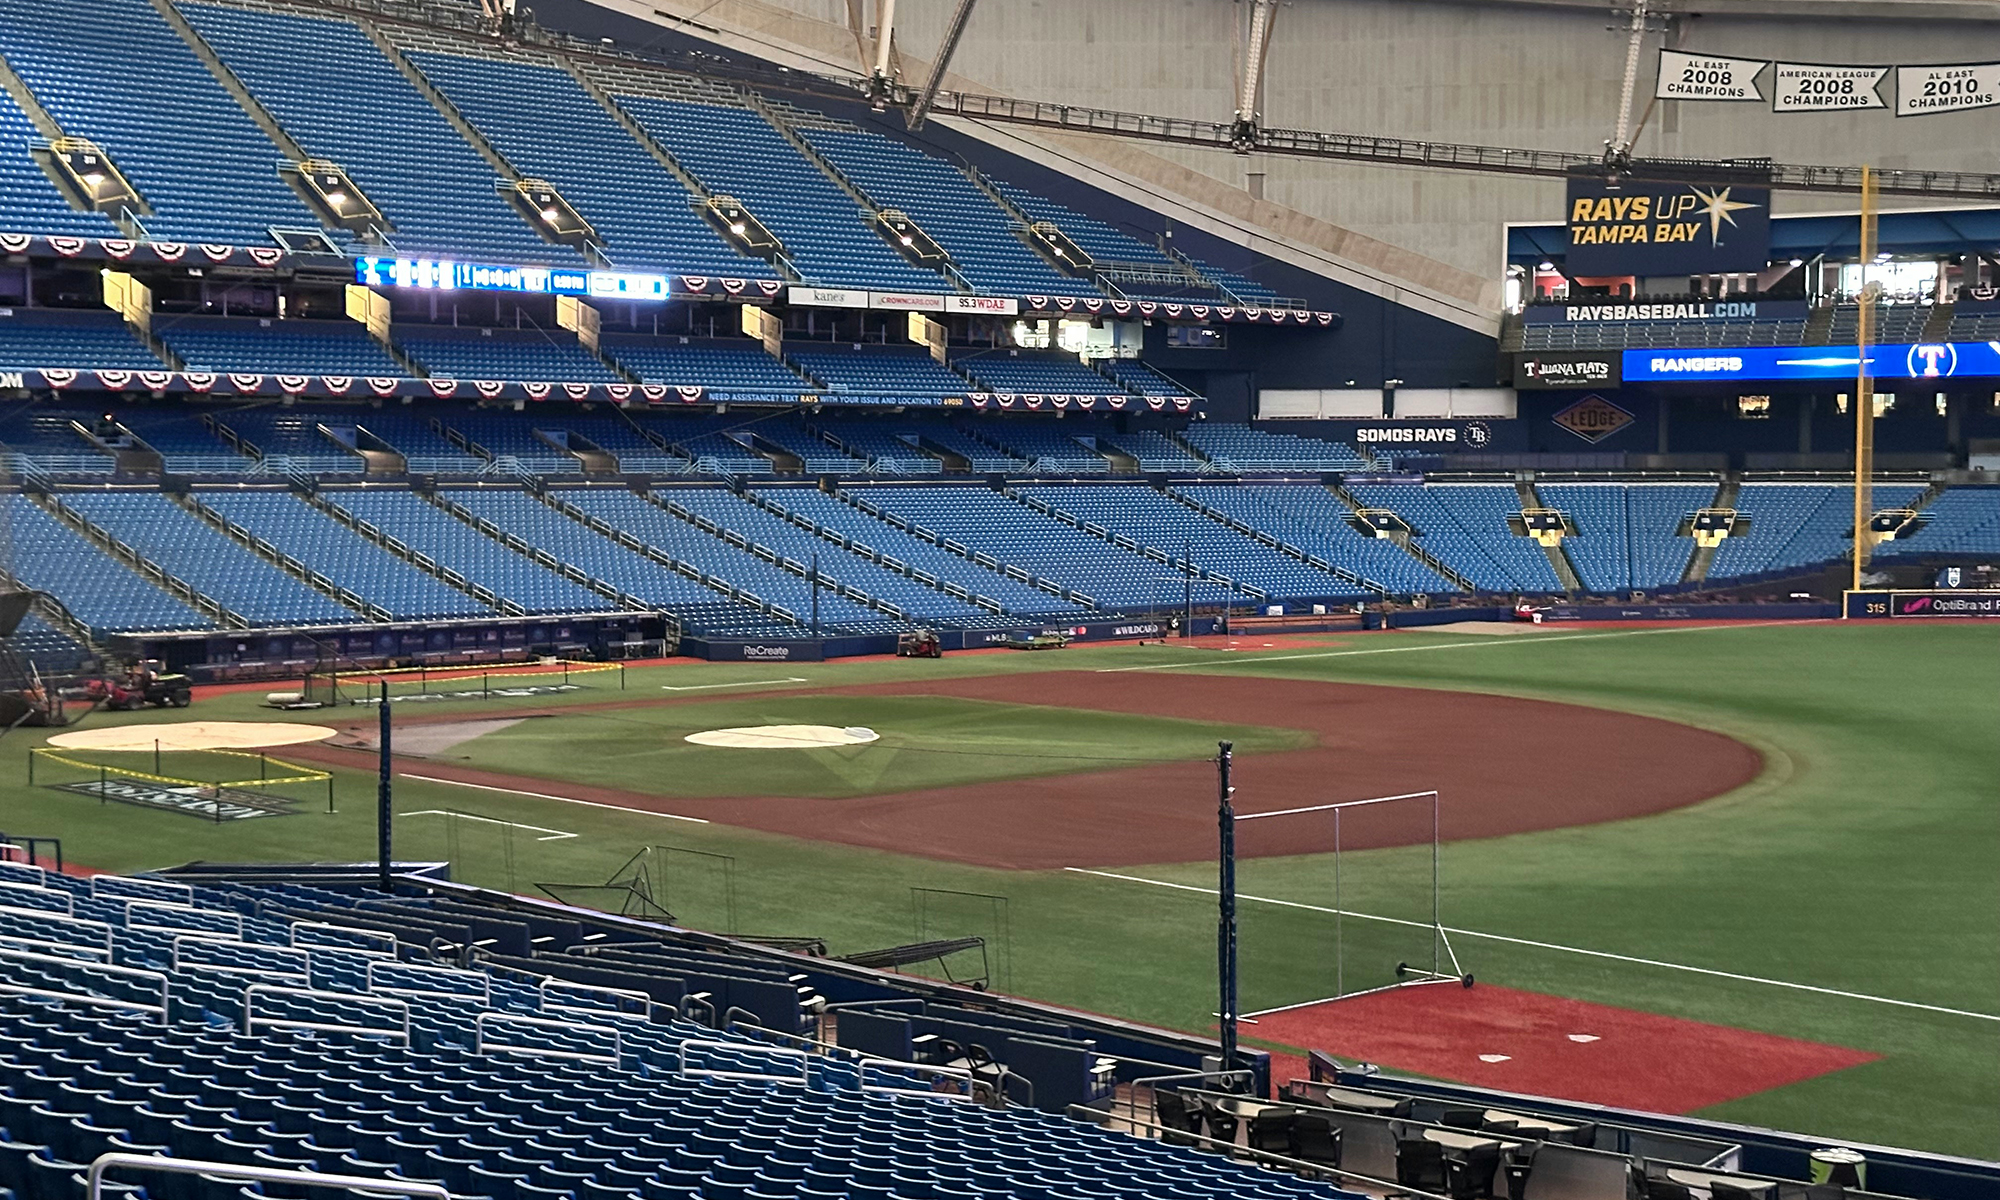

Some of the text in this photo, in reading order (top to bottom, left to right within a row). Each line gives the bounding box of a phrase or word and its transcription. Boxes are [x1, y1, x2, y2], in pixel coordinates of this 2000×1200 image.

[1704, 61, 1730, 69] EAST
[1682, 69, 1732, 85] 2008
[1946, 70, 1974, 79] EAST
[1667, 83, 1744, 97] CHAMPIONS
[1799, 79, 1853, 95] 2008
[1924, 79, 1978, 96] 2010
[1783, 95, 1868, 105] CHAMPIONS
[1909, 94, 1992, 108] CHAMPIONS
[1572, 195, 1696, 222] RAYS UP
[1572, 222, 1702, 244] TAMPA BAY
[977, 299, 1005, 309] WDAE
[1566, 303, 1757, 321] RAYSBASEBALL.COM
[1576, 362, 1609, 375] FLATS
[1651, 357, 1743, 372] RANGERS
[709, 393, 730, 401] NEED
[731, 393, 779, 402] ASSISTANCE?
[781, 394, 798, 402] TEXT
[800, 395, 818, 403] RAYS
[840, 396, 859, 404] YOUR
[861, 396, 879, 404] ISSUE
[898, 397, 931, 405] LOCATION
[933, 397, 942, 405] TO
[1570, 410, 1616, 427] LEDGE
[1357, 428, 1456, 442] SOMOS RAYS
[1867, 603, 1886, 613] 315
[744, 645, 789, 655] ReCreate
